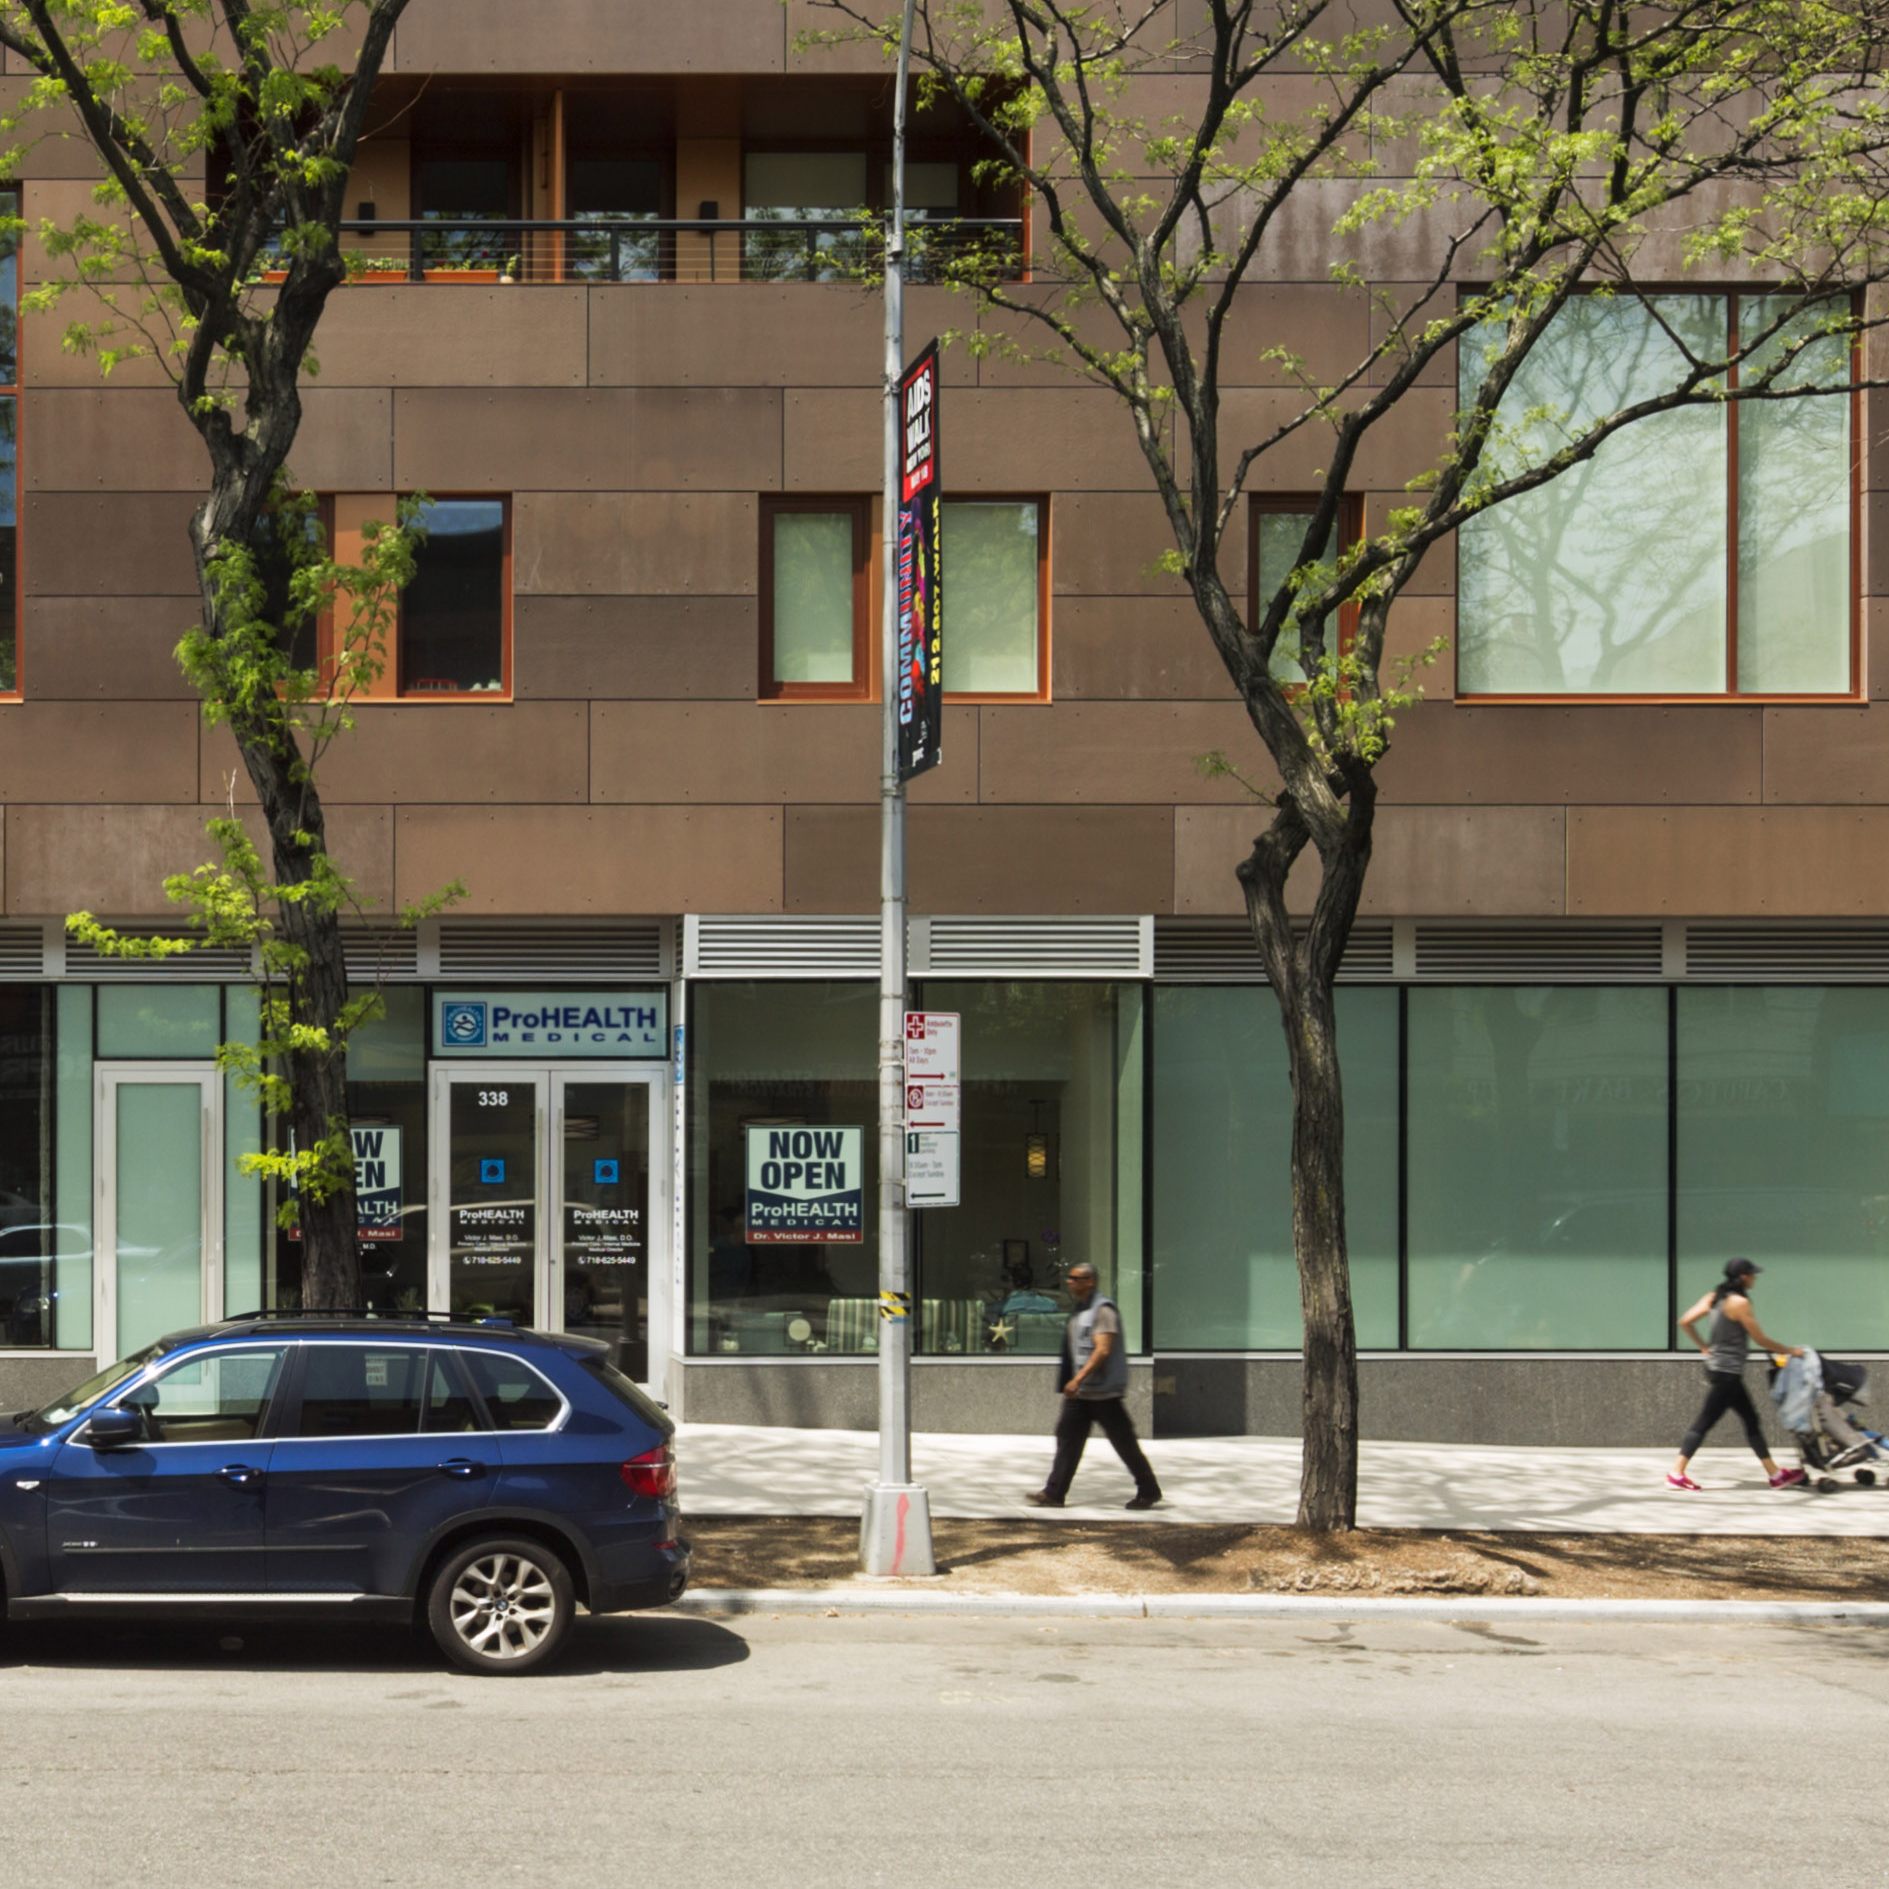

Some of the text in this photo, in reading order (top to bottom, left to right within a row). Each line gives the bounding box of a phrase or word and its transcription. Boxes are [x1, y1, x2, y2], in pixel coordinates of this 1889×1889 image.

[906, 368, 932, 423] AIDS
[906, 406, 931, 454] WALK
[899, 510, 913, 726] COMMUNITY
[492, 1007, 656, 1029] ProHEALTH
[493, 1033, 656, 1042] MEDICAL
[478, 1091, 508, 1106] 338
[769, 1131, 844, 1159] NOW
[910, 1135, 917, 1152] 1
[760, 1161, 846, 1190] OPEN
[459, 1210, 524, 1219] ProHEALTH
[573, 1210, 639, 1219] ProHEALTH
[751, 1203, 858, 1217] ProHEALTH
